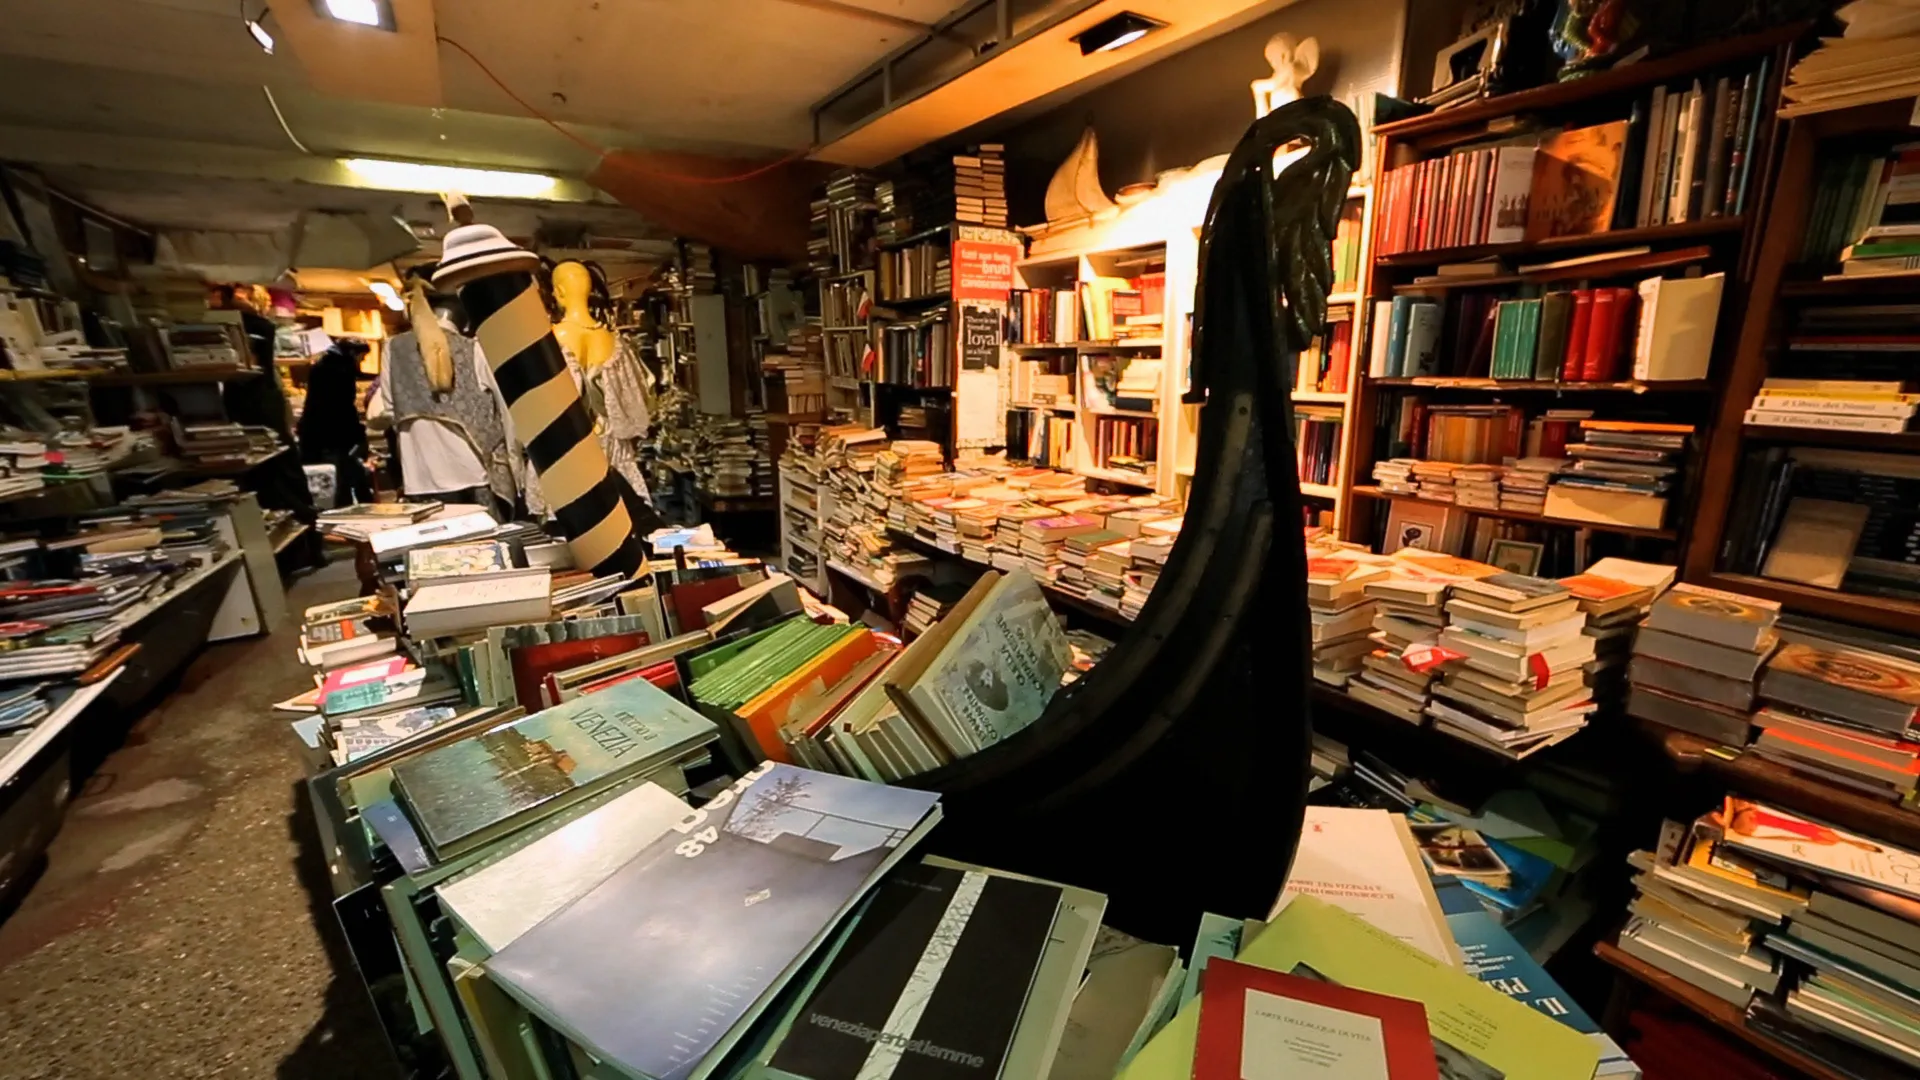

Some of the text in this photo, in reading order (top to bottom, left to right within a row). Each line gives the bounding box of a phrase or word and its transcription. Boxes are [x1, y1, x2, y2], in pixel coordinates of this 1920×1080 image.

[967, 330, 999, 351] loyal
[569, 707, 639, 760] VENEZIA
[675, 825, 719, 858] 48
[1535, 996, 1570, 1016] IL
